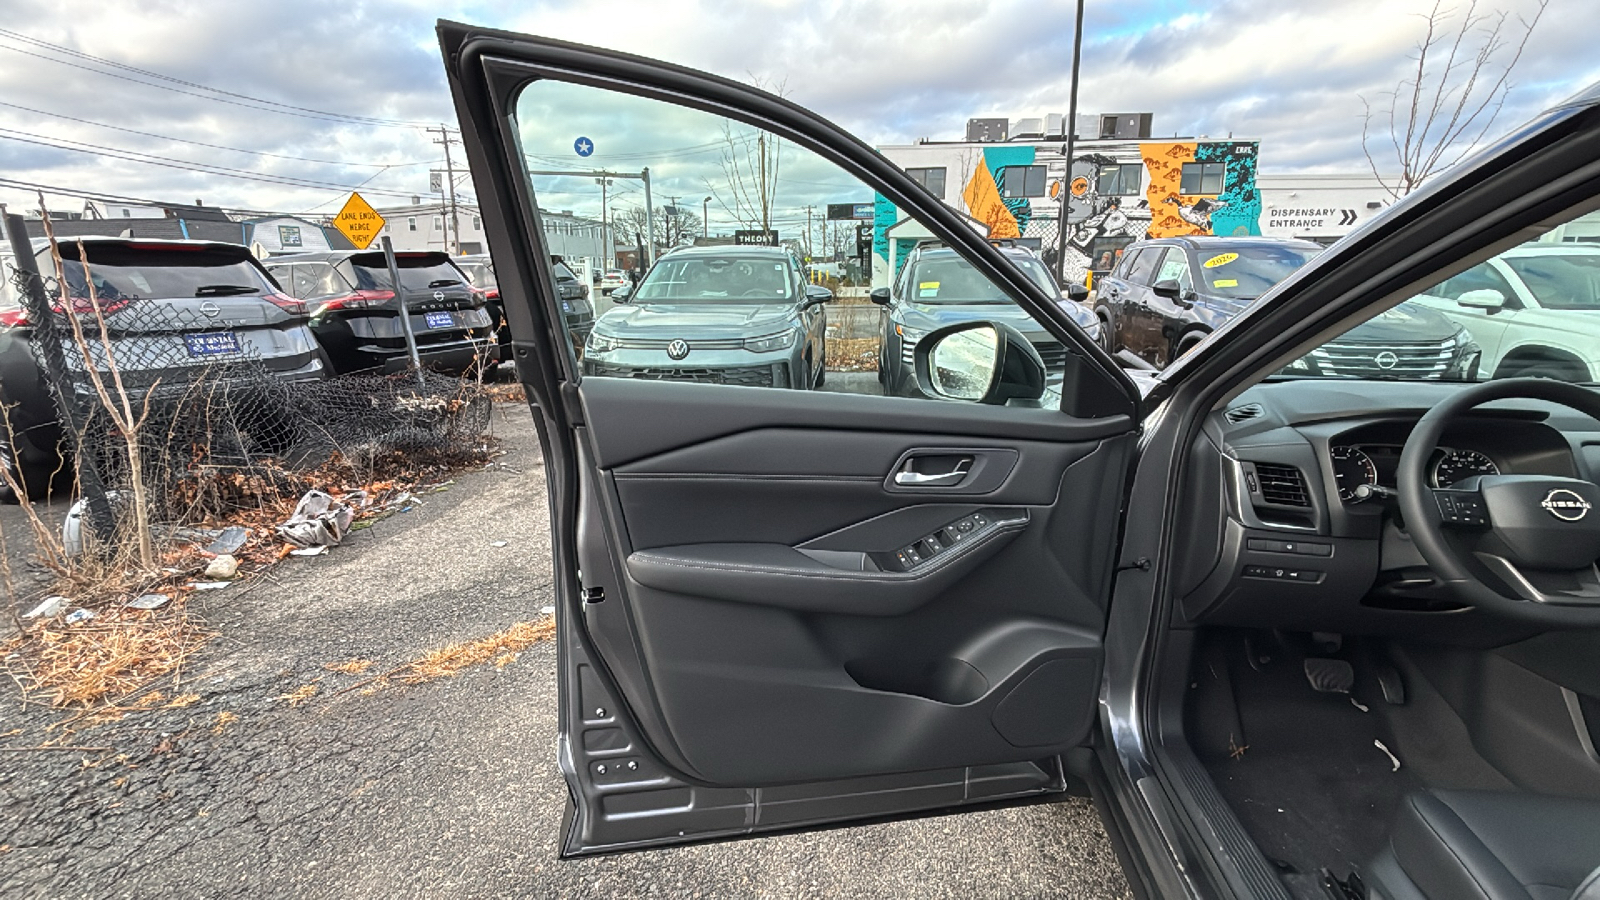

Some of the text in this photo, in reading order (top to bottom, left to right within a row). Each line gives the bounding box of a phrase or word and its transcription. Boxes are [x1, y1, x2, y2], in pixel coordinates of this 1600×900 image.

[341, 211, 376, 220] LANE ENDS
[1271, 208, 1336, 217] DISPENSARY
[349, 223, 370, 231] MERGE
[1269, 219, 1323, 227] ENTRANCE
[352, 234, 370, 242] RIGHT
[739, 234, 773, 243] THEORY
